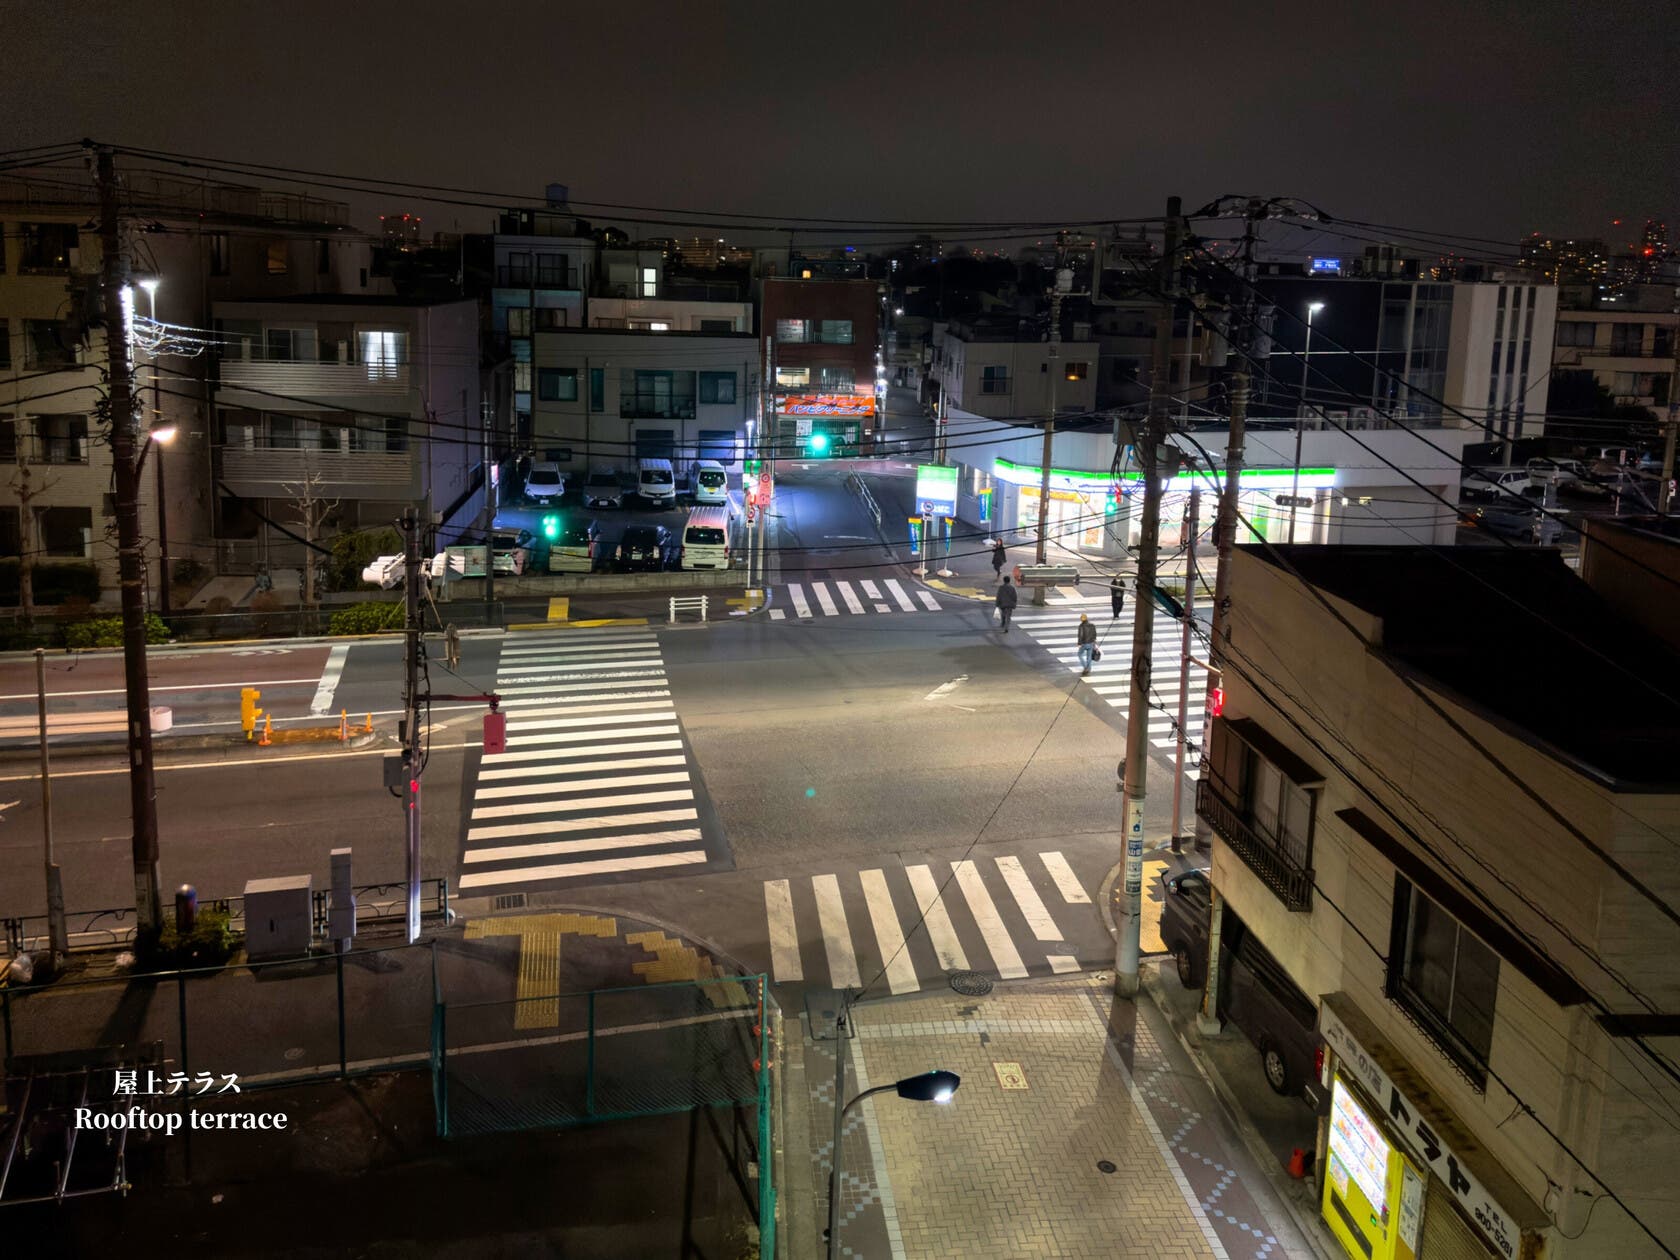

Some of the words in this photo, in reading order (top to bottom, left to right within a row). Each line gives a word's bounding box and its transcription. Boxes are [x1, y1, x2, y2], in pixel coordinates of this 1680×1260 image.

[1388, 1086, 1471, 1197] トラヤ
[1484, 1202, 1508, 1235] TEL
